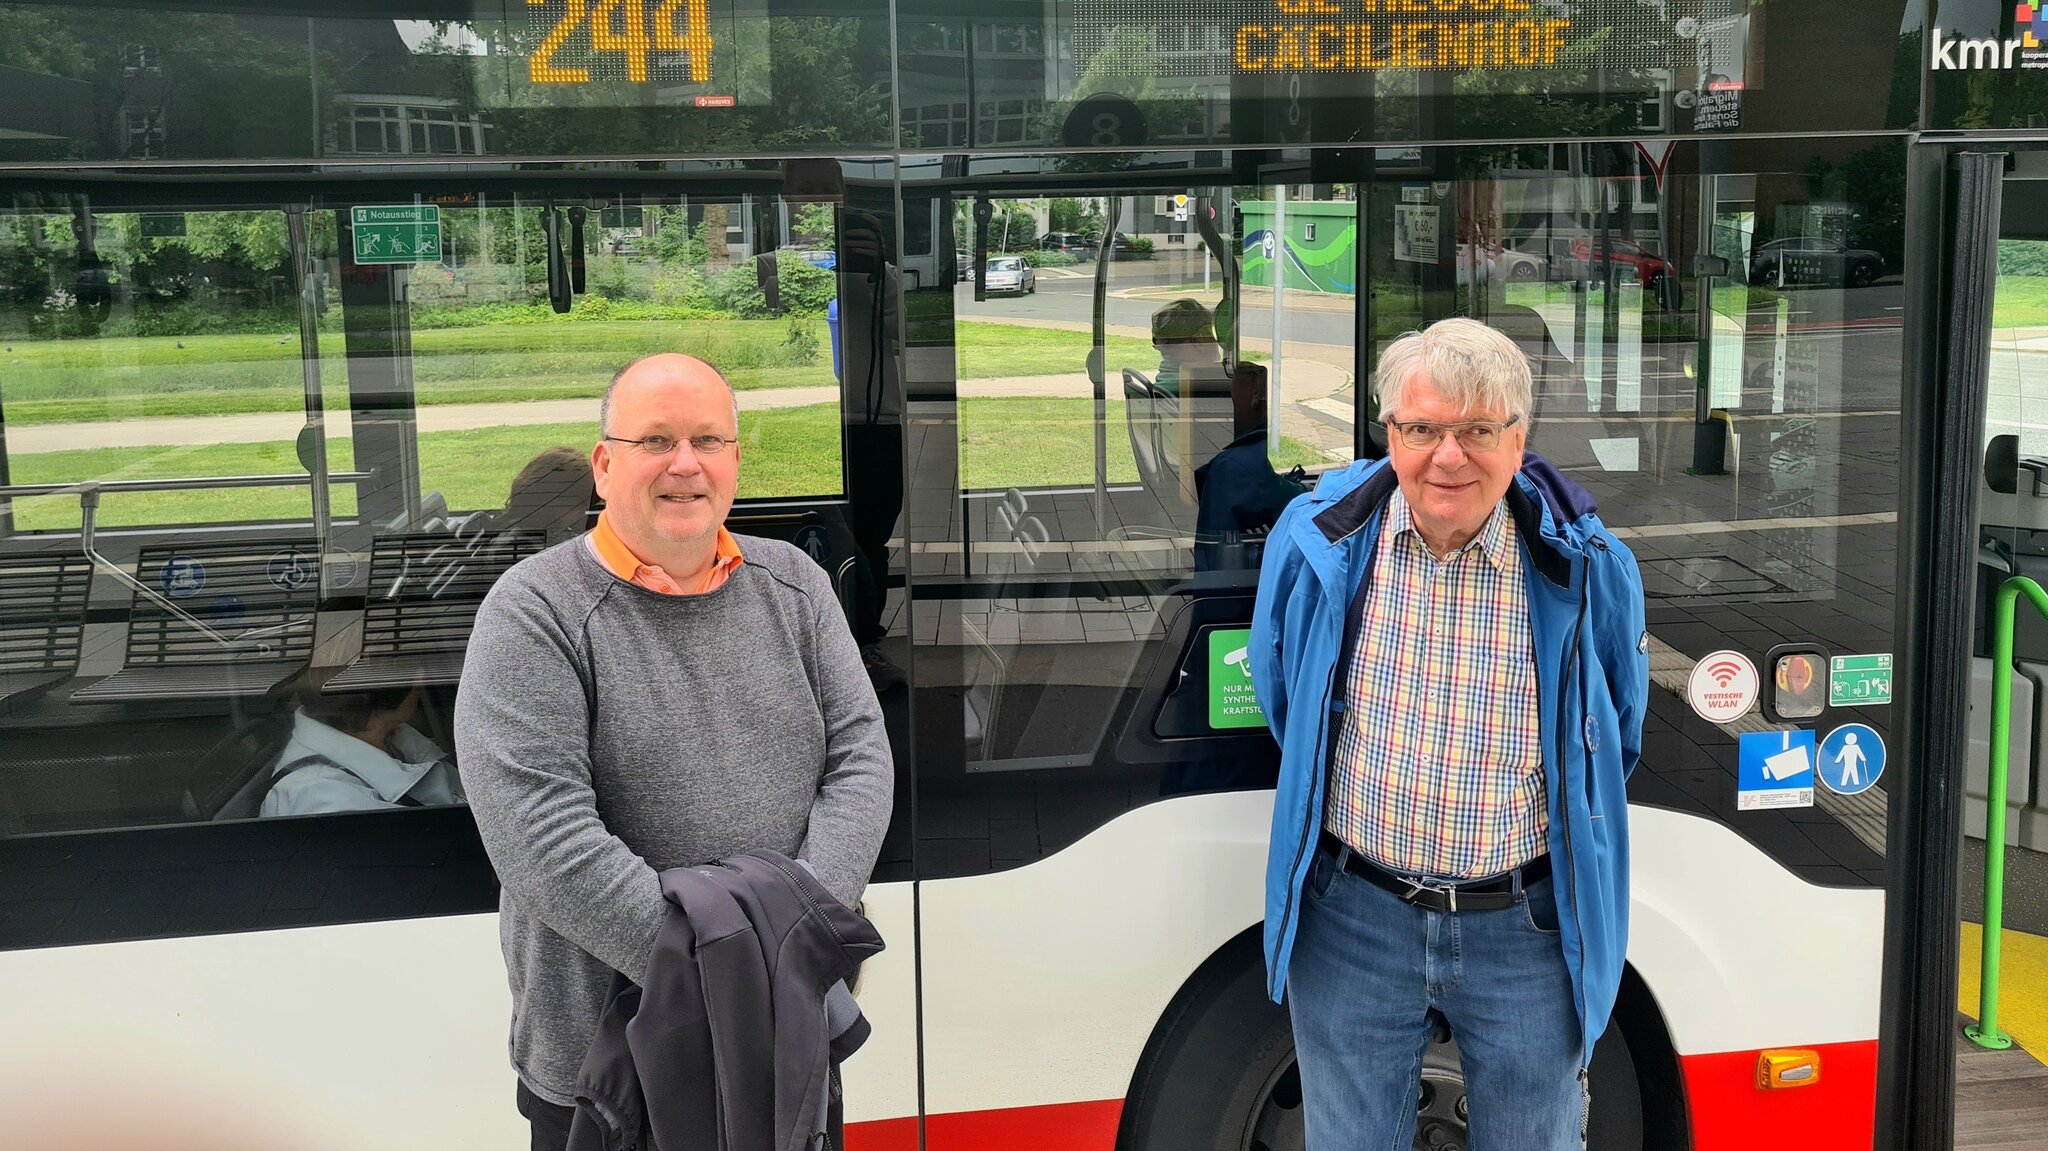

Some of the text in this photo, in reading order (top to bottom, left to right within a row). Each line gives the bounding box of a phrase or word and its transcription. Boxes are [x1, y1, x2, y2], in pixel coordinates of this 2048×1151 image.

[526, 0, 713, 83] 244
[1236, 19, 1571, 69] CÄCILIENHOF
[1931, 28, 2020, 70] kmr
[370, 210, 421, 220] Notausstieg
[1223, 685, 1242, 693] NUR
[1223, 695, 1256, 704] SYNTHE
[1703, 692, 1743, 700] VESTISCHE
[1708, 700, 1738, 709] WLAN
